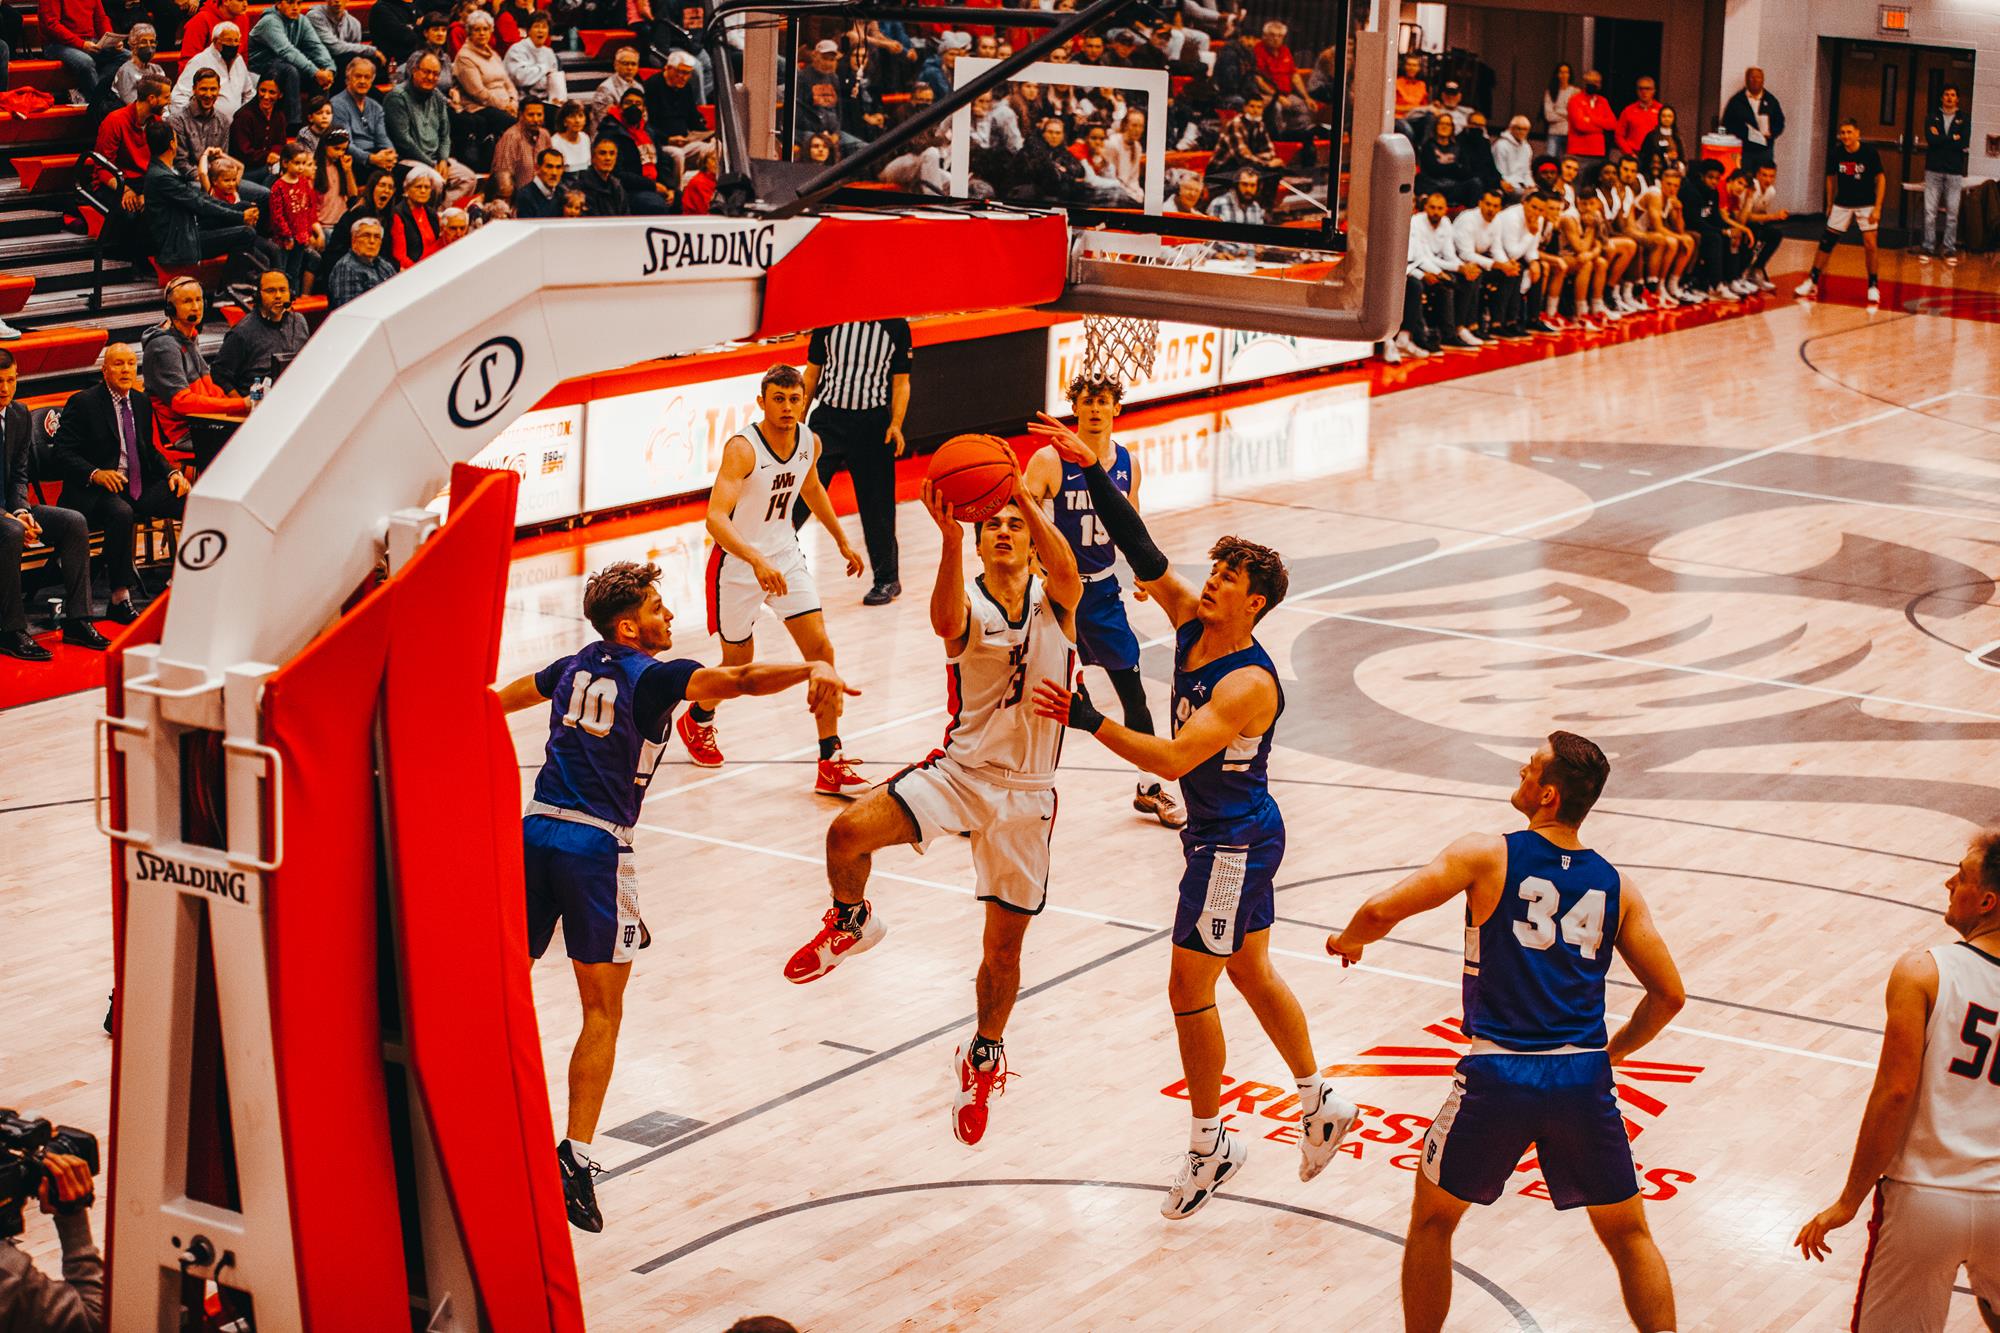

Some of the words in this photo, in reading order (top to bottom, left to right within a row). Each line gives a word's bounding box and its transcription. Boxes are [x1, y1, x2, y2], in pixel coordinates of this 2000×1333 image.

[643, 224, 774, 276] SPALDING
[764, 491, 792, 522] 14
[562, 669, 619, 738] 10
[136, 850, 245, 904] SPALDING
[1512, 875, 1607, 960] 34
